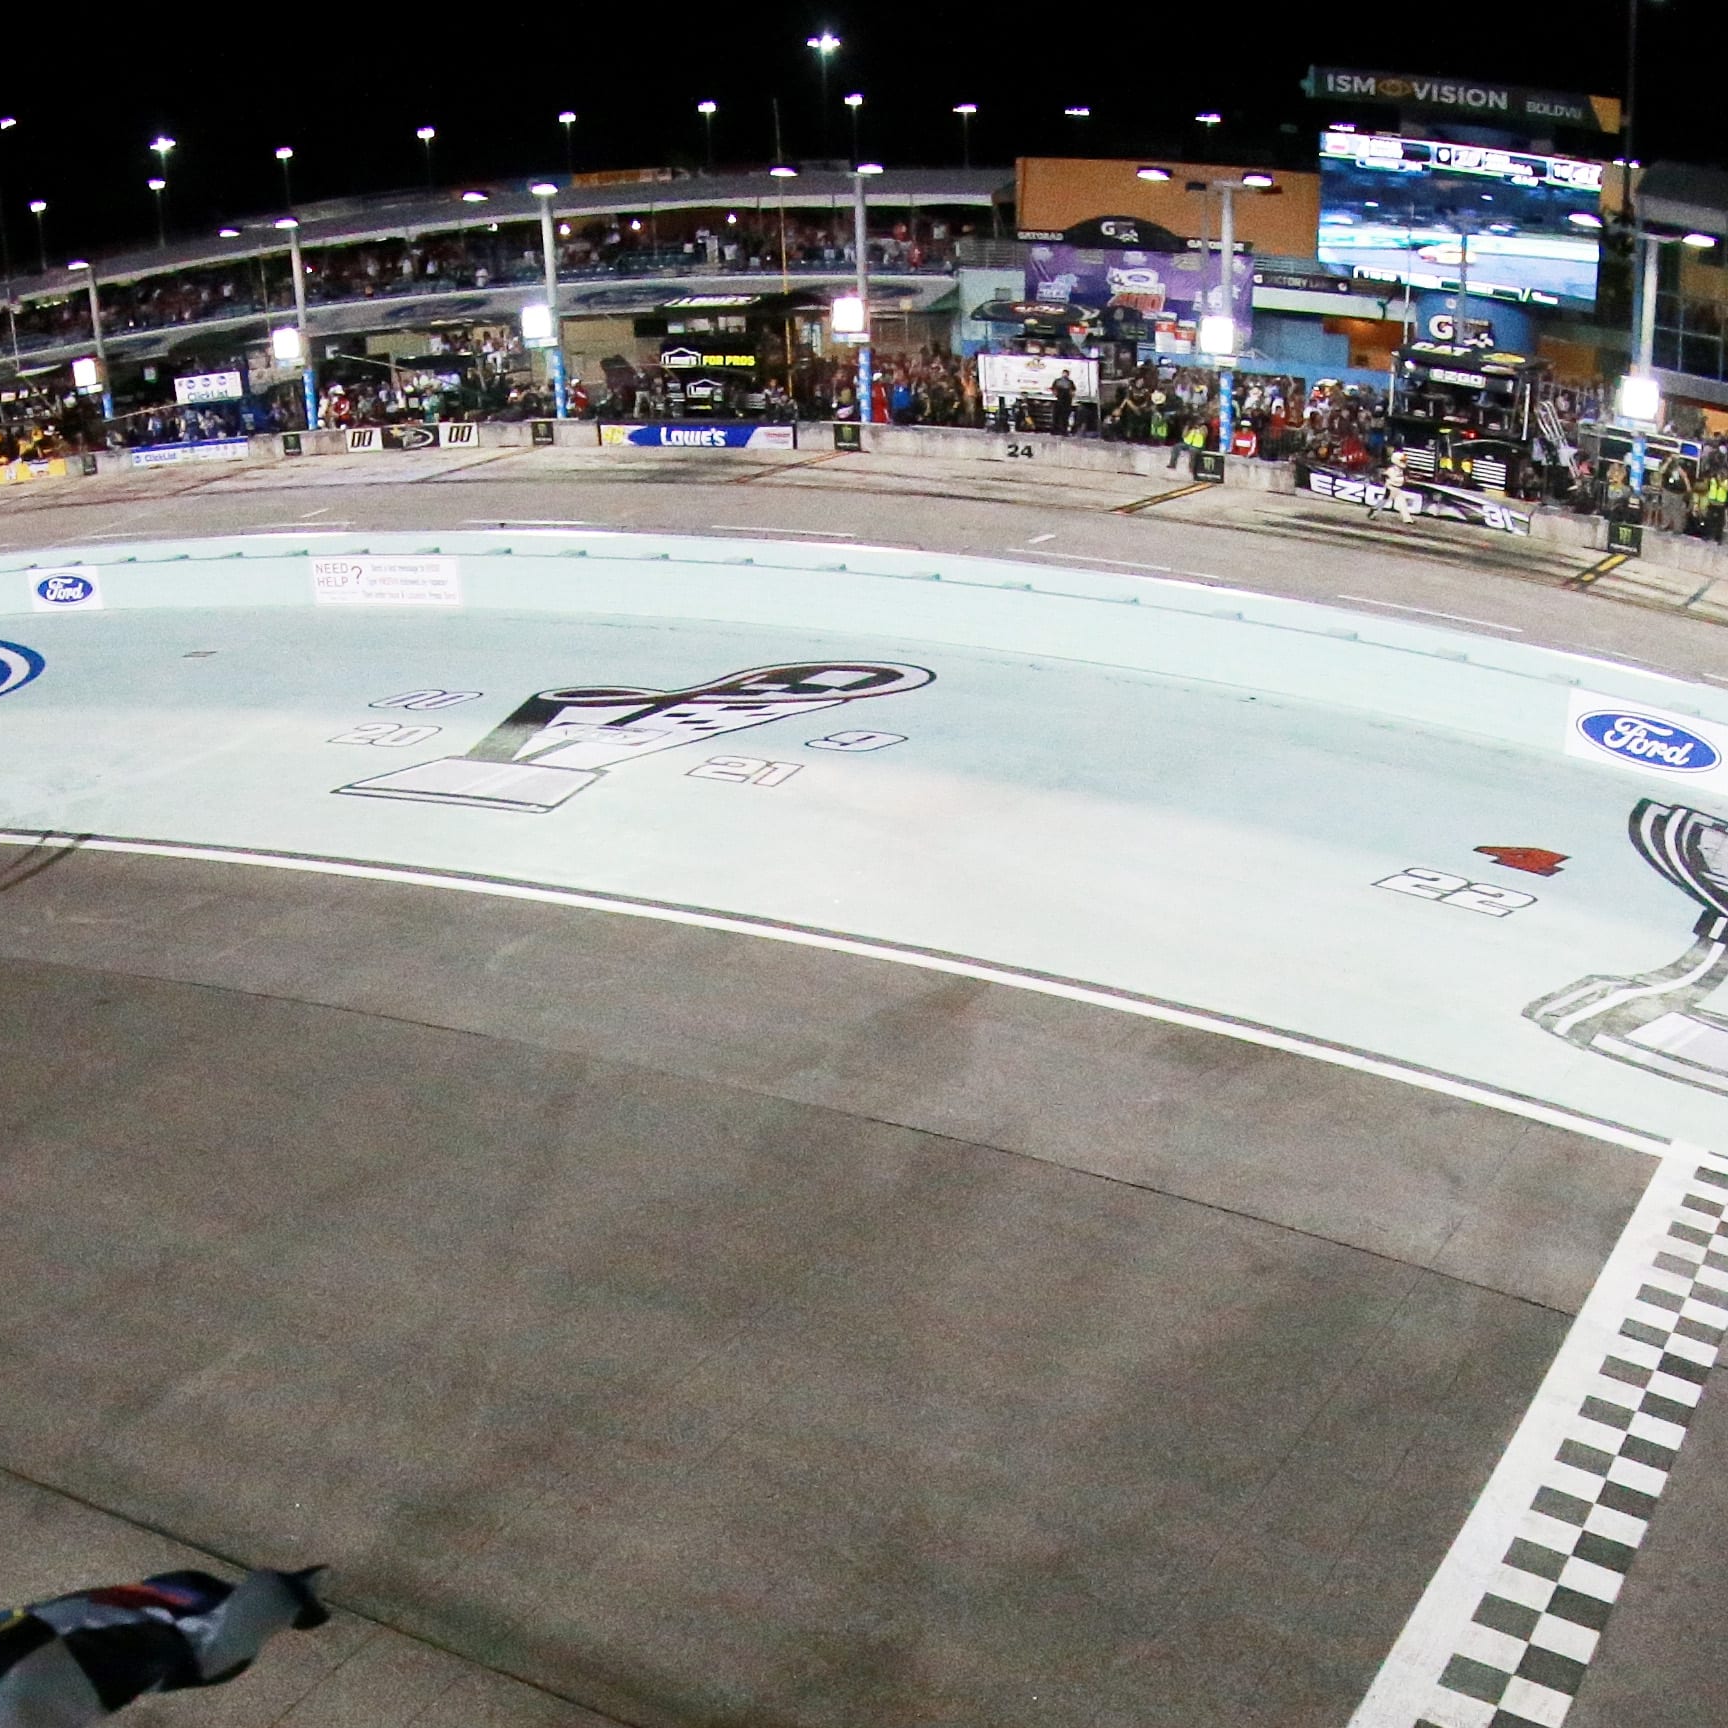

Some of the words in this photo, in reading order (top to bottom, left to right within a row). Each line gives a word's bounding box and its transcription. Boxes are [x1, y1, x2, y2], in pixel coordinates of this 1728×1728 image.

[1326, 72, 1377, 96] ISM
[1412, 79, 1508, 110] VISION
[1429, 314, 1453, 340] G
[1006, 443, 1034, 460] 24
[315, 562, 349, 575] NEED
[317, 576, 349, 588] HELP
[46, 575, 88, 603] Ford
[327, 723, 445, 748] 20
[1604, 716, 1697, 769] Ford
[682, 754, 806, 788] 21
[1369, 865, 1539, 918] 22
